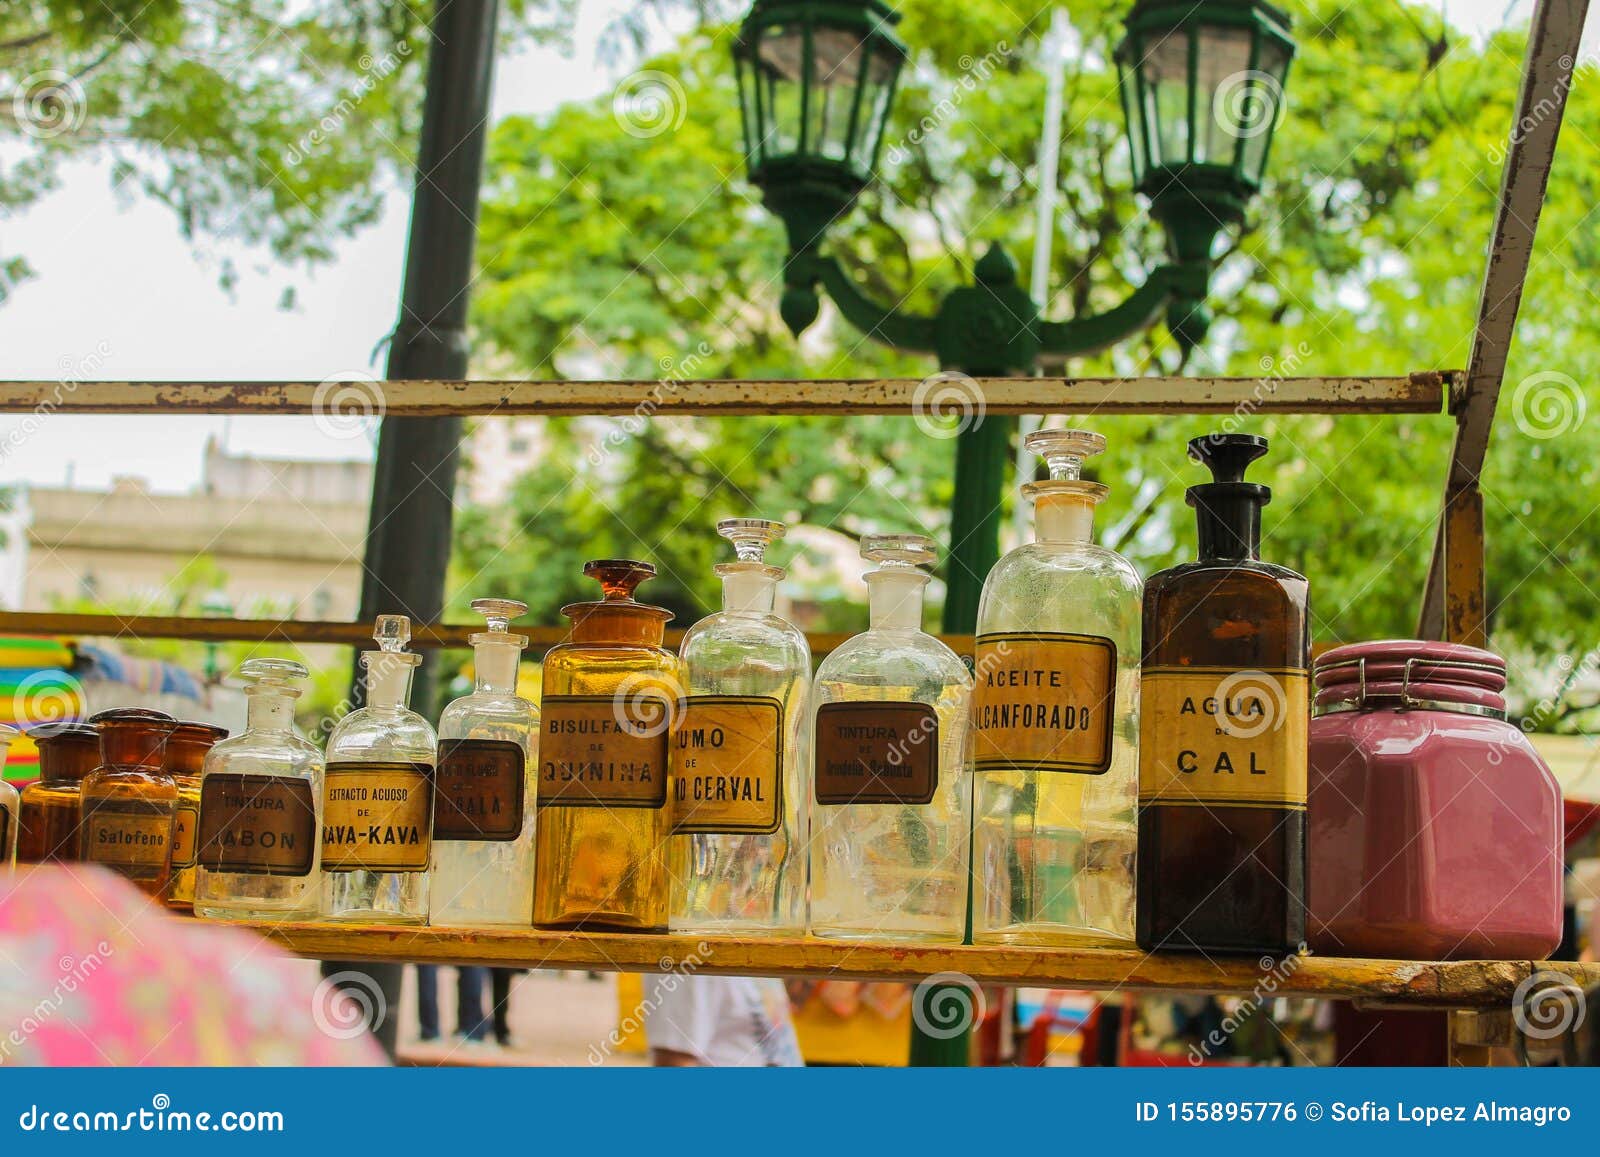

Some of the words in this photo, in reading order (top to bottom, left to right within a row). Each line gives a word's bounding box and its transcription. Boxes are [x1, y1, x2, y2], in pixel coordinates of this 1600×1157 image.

[986, 670, 1061, 688] ACEITE
[1180, 697, 1265, 716] AGUA
[549, 719, 648, 735] BISULFATO
[837, 726, 899, 741] TINTURA
[1215, 727, 1230, 736] DE
[589, 743, 605, 752] DE
[685, 759, 697, 769] DE
[1176, 750, 1266, 775] CAL
[543, 762, 653, 783] QUININA
[329, 787, 367, 801] EXTRACTO
[693, 776, 765, 802] CERVAL
[223, 796, 286, 811] TINTURA
[358, 808, 370, 817] DE
[99, 828, 164, 846] Salofeno
